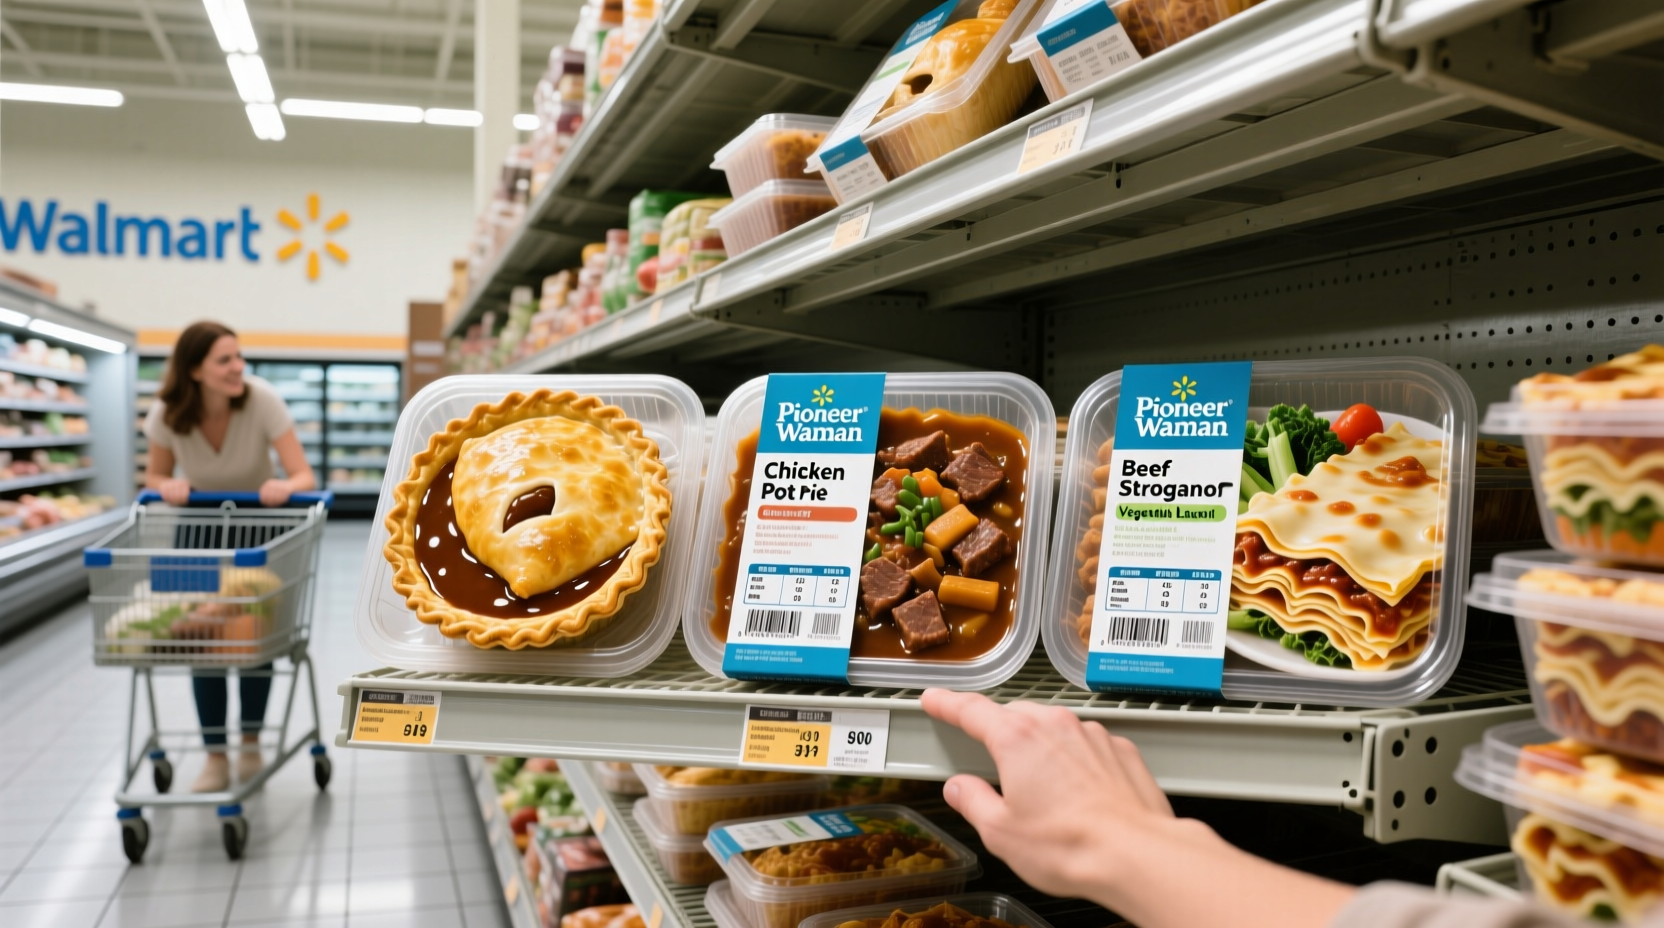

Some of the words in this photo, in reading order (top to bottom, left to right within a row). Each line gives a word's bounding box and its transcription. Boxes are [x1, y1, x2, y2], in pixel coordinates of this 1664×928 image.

[0, 199, 260, 262] Walmart
[776, 402, 863, 423] Pioneer
[1134, 396, 1229, 418] Pioneer
[775, 422, 863, 442] Waman
[1134, 417, 1229, 437] Waman
[764, 461, 845, 480] Chicken
[1121, 459, 1173, 477] Beef
[761, 482, 796, 501] Pot
